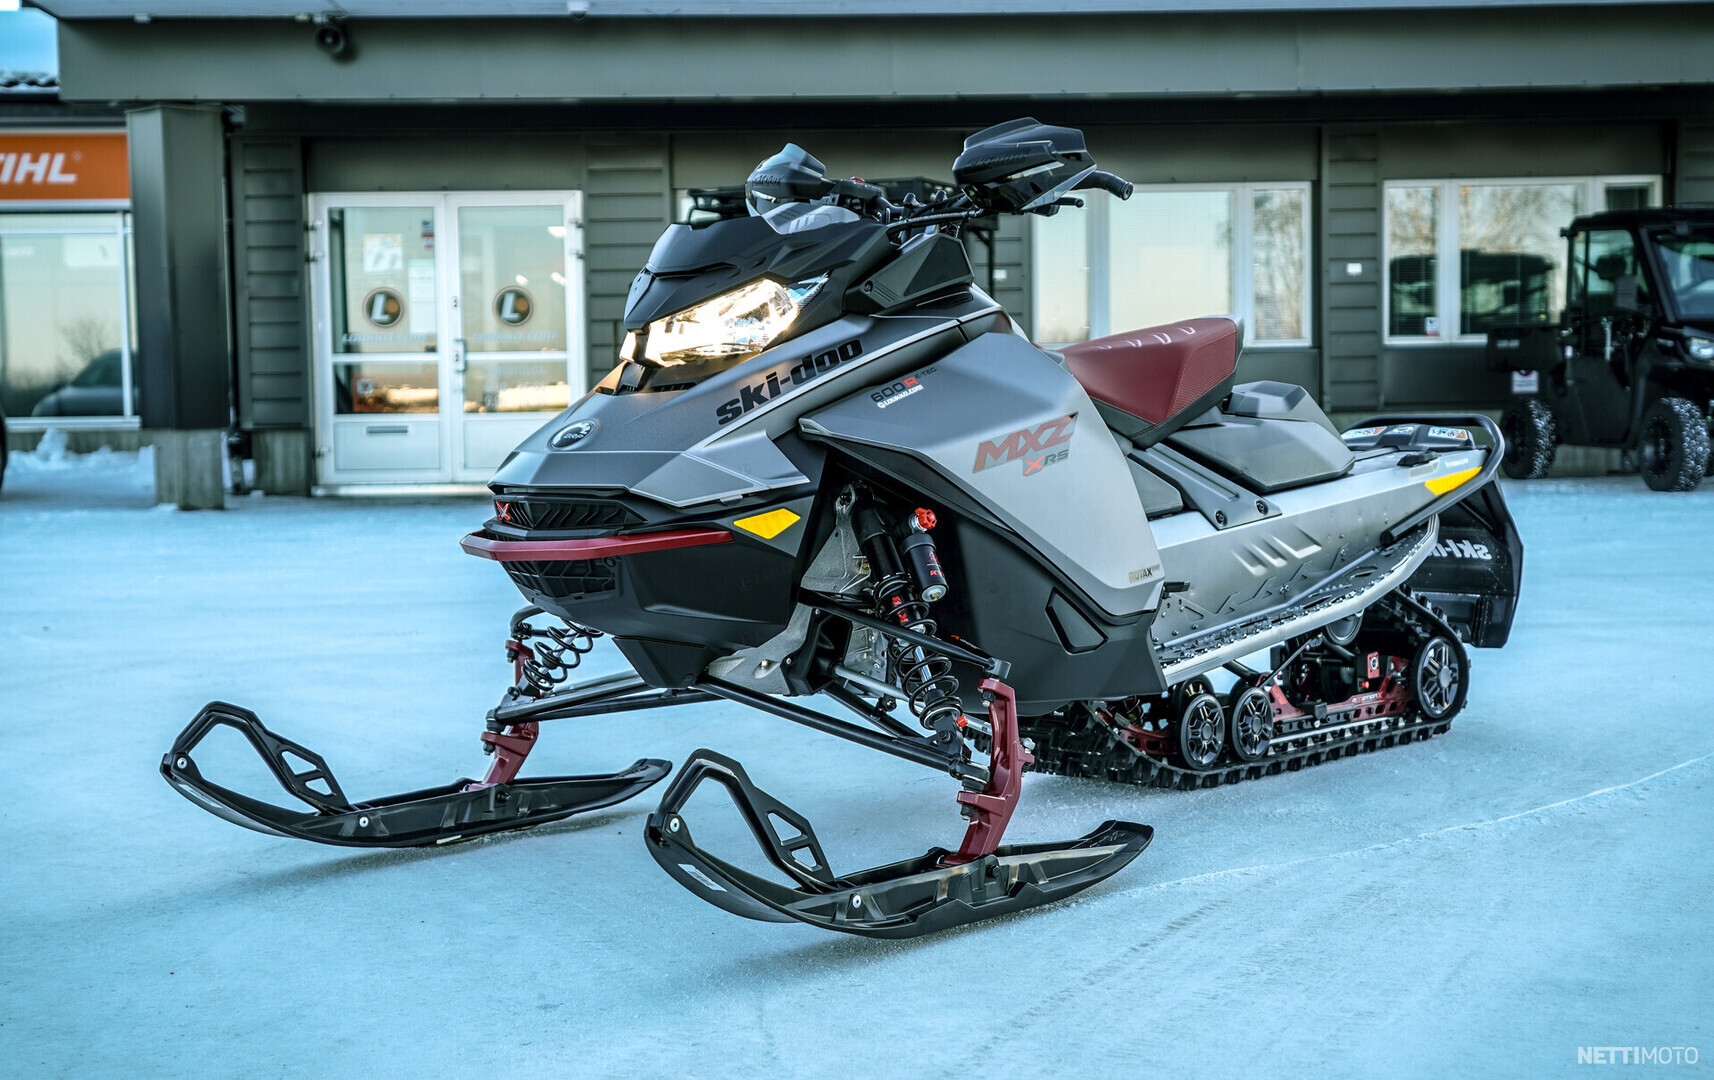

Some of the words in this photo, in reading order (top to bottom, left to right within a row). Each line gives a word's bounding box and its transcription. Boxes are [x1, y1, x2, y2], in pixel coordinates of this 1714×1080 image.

[0, 152, 77, 184] IHL
[870, 376, 919, 403] 600R
[914, 367, 937, 379] E-TEC
[974, 414, 1075, 472] MXZ
